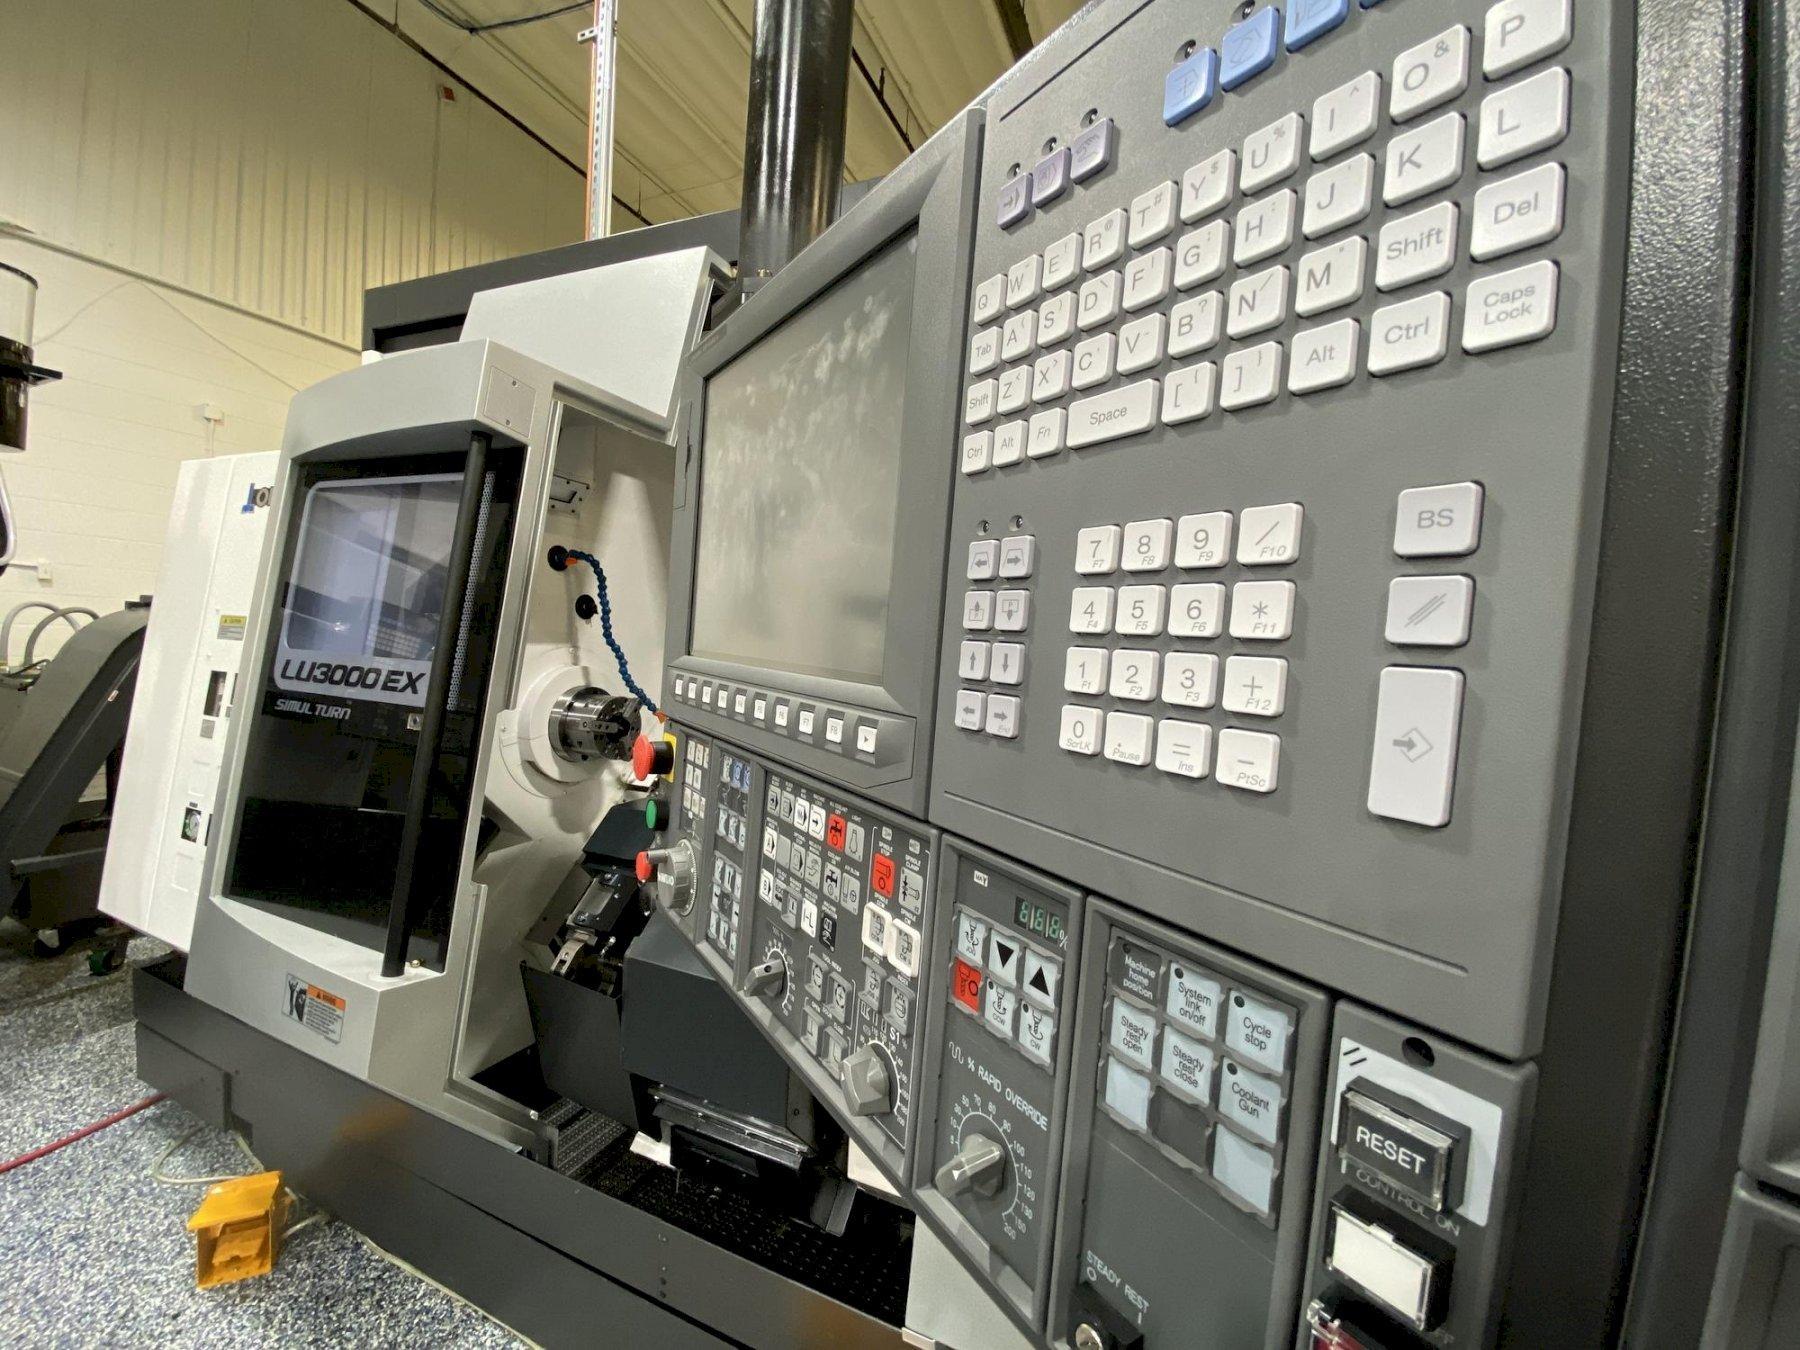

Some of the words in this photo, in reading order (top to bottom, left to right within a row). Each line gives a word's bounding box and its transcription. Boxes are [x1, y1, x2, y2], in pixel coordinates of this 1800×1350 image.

[1500, 14, 1525, 49] P
[1403, 62, 1429, 91] O
[1498, 108, 1521, 136] L
[1251, 142, 1269, 170] U
[1397, 143, 1422, 177] K
[1190, 176, 1206, 200] Y
[1316, 182, 1335, 210] J
[1137, 208, 1152, 228] T
[1494, 192, 1539, 224] Del
[1245, 215, 1263, 243] H
[1090, 233, 1101, 253] R
[1386, 227, 1444, 260] Shift
[1049, 255, 1059, 274] E
[1183, 245, 1200, 267] G
[1009, 274, 1024, 293] W
[1132, 269, 1145, 291] F
[1306, 262, 1331, 292] M
[978, 295, 988, 310] Q
[1084, 292, 1098, 312] D
[1238, 290, 1256, 317] N
[1483, 285, 1535, 309] Caps
[1044, 311, 1054, 329] S
[1483, 302, 1532, 326] Lock
[1178, 314, 1193, 337] B
[1384, 316, 1430, 344] Ctrl
[1006, 329, 1018, 345] A
[1125, 332, 1141, 354] V
[975, 343, 992, 358] Tab
[1305, 345, 1336, 366] Alt
[1078, 353, 1092, 371] C
[1038, 367, 1050, 387] X
[968, 392, 989, 409] Shift
[1002, 381, 1013, 400] Z
[1089, 405, 1128, 426] Space
[1001, 435, 1014, 449] Alt
[1036, 425, 1051, 441] Fn
[967, 445, 983, 459] Ctrl
[1417, 508, 1454, 529] BS
[1089, 540, 1102, 559] 7
[1137, 535, 1151, 555] 8
[1193, 529, 1209, 550] 9
[1141, 555, 1155, 566] F8
[1198, 551, 1213, 561] F9
[1259, 545, 1287, 558] F10
[1092, 559, 1104, 568] F7
[1083, 601, 1095, 619] 4
[1131, 600, 1144, 620] 5
[1186, 600, 1202, 620] 6
[1086, 620, 1098, 629] F4
[1135, 620, 1148, 630] F5
[1191, 622, 1207, 632] F6
[1252, 623, 1277, 633] F11
[1079, 661, 1086, 679] 1
[1125, 664, 1139, 684] 2
[1180, 669, 1195, 690] 3
[1081, 680, 1092, 690] F1
[1129, 685, 1143, 695] F2
[1185, 691, 1200, 702] F3
[1245, 698, 1272, 710] F12
[1073, 720, 1085, 739] 0
[1112, 747, 1140, 761] Pause
[1178, 761, 1194, 773] Ins
[1124, 955, 1156, 979] Machine
[1122, 978, 1153, 999] position
[1128, 970, 1149, 987] home
[1178, 981, 1212, 1007] System
[1185, 996, 1201, 1013] link
[1179, 1007, 1207, 1026] on/off
[1121, 1016, 1149, 1039] Steady
[1125, 1028, 1141, 1045] rest
[1243, 1016, 1272, 1039] Cycle
[1122, 1038, 1143, 1055] open
[1245, 1033, 1267, 1052] stop
[1173, 1045, 1204, 1072] Steady
[1174, 1068, 1198, 1088] close
[1179, 1061, 1197, 1077] rest
[978, 1065, 1002, 1093] RAPID
[1006, 1088, 1048, 1132] OVERRIDE
[1231, 1082, 1270, 1111] Coolant
[1238, 1099, 1260, 1119] Gun
[1356, 1125, 1426, 1175] RESET
[1356, 1168, 1430, 1219] CONTROL
[1435, 1214, 1460, 1236] ON
[1087, 1250, 1121, 1287] STEADY
[1125, 1284, 1150, 1313] REST
